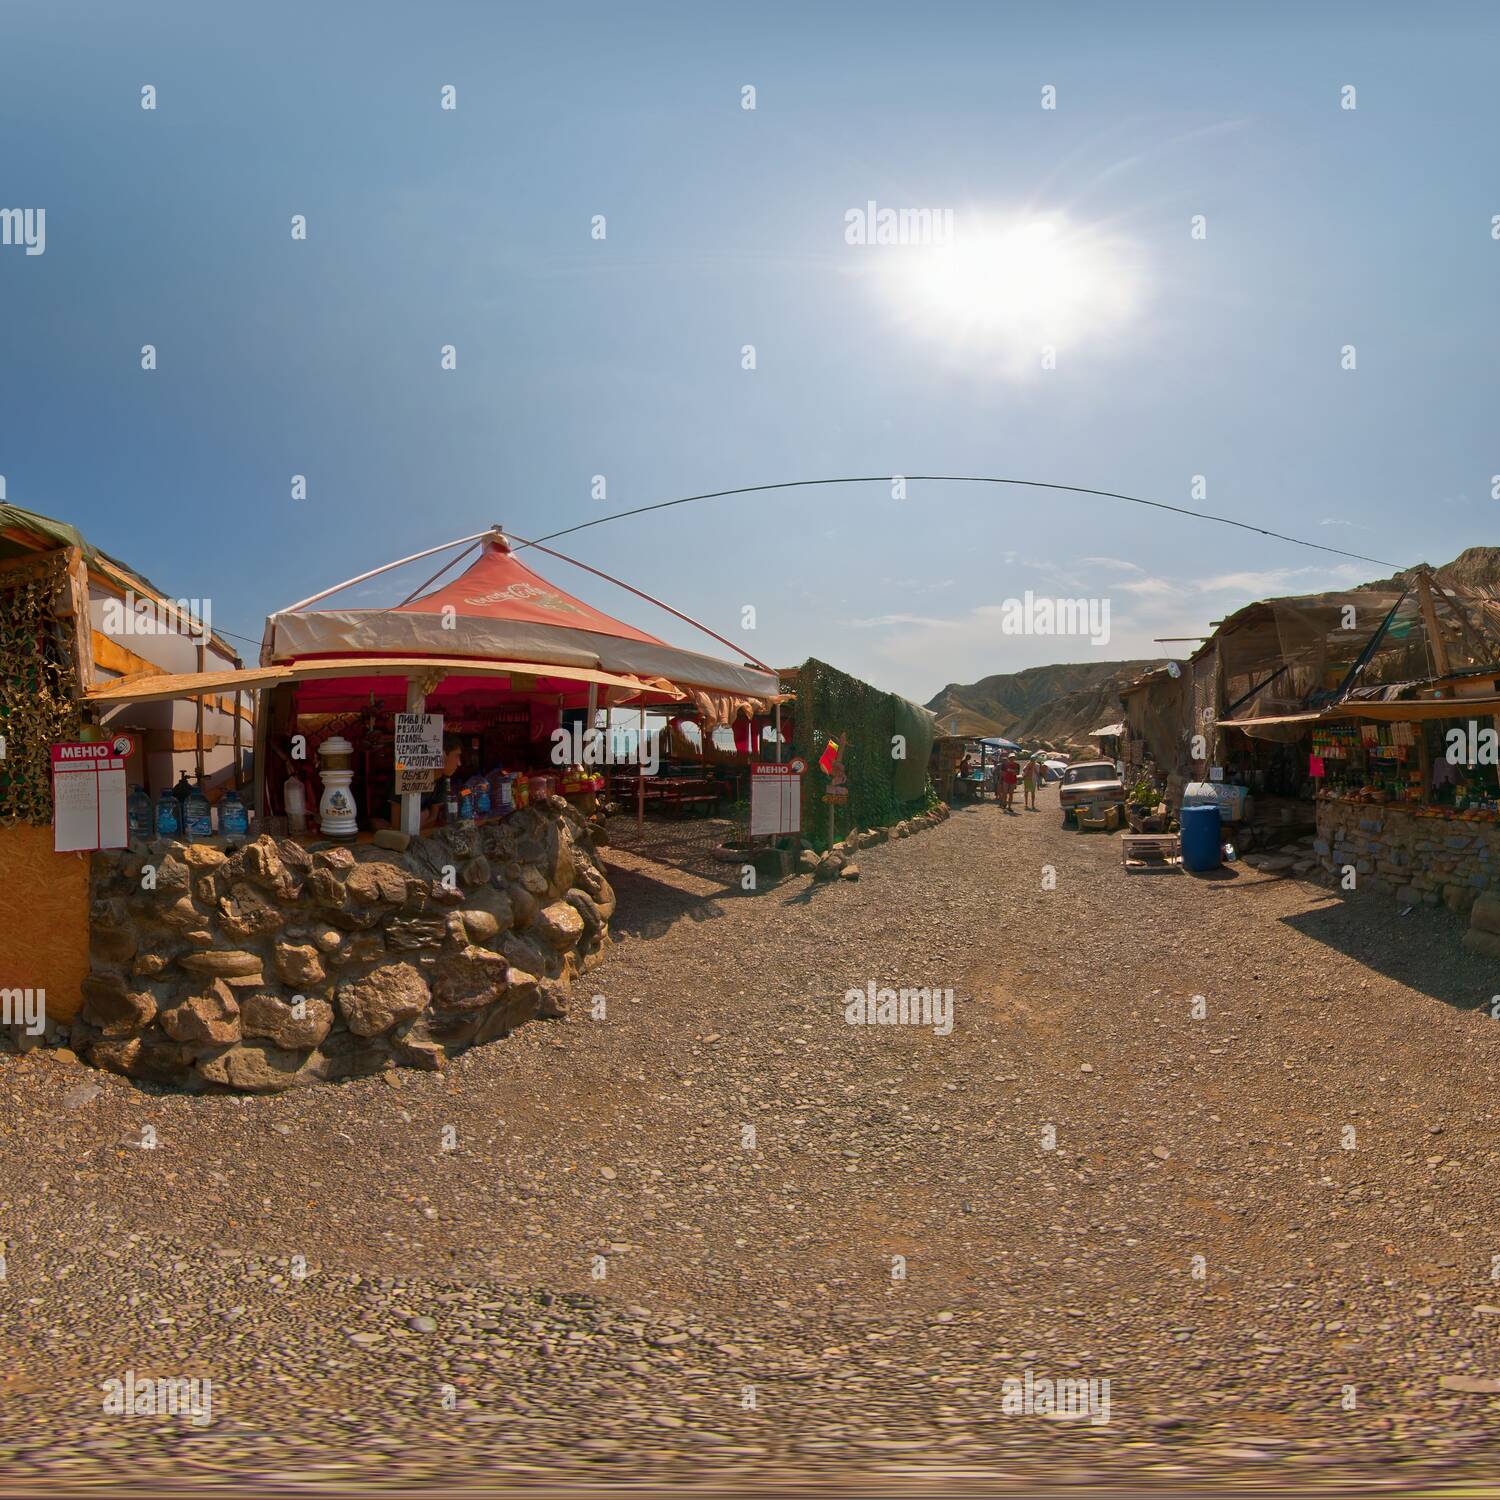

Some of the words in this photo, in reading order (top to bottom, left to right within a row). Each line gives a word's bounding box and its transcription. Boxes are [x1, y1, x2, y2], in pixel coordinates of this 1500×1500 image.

[398, 714, 419, 725] ПИВО
[421, 714, 432, 725] НА
[397, 725, 424, 734] РОЗЛИВ
[61, 746, 109, 758] МЕНЮ
[757, 766, 788, 774] МЕНЮ
